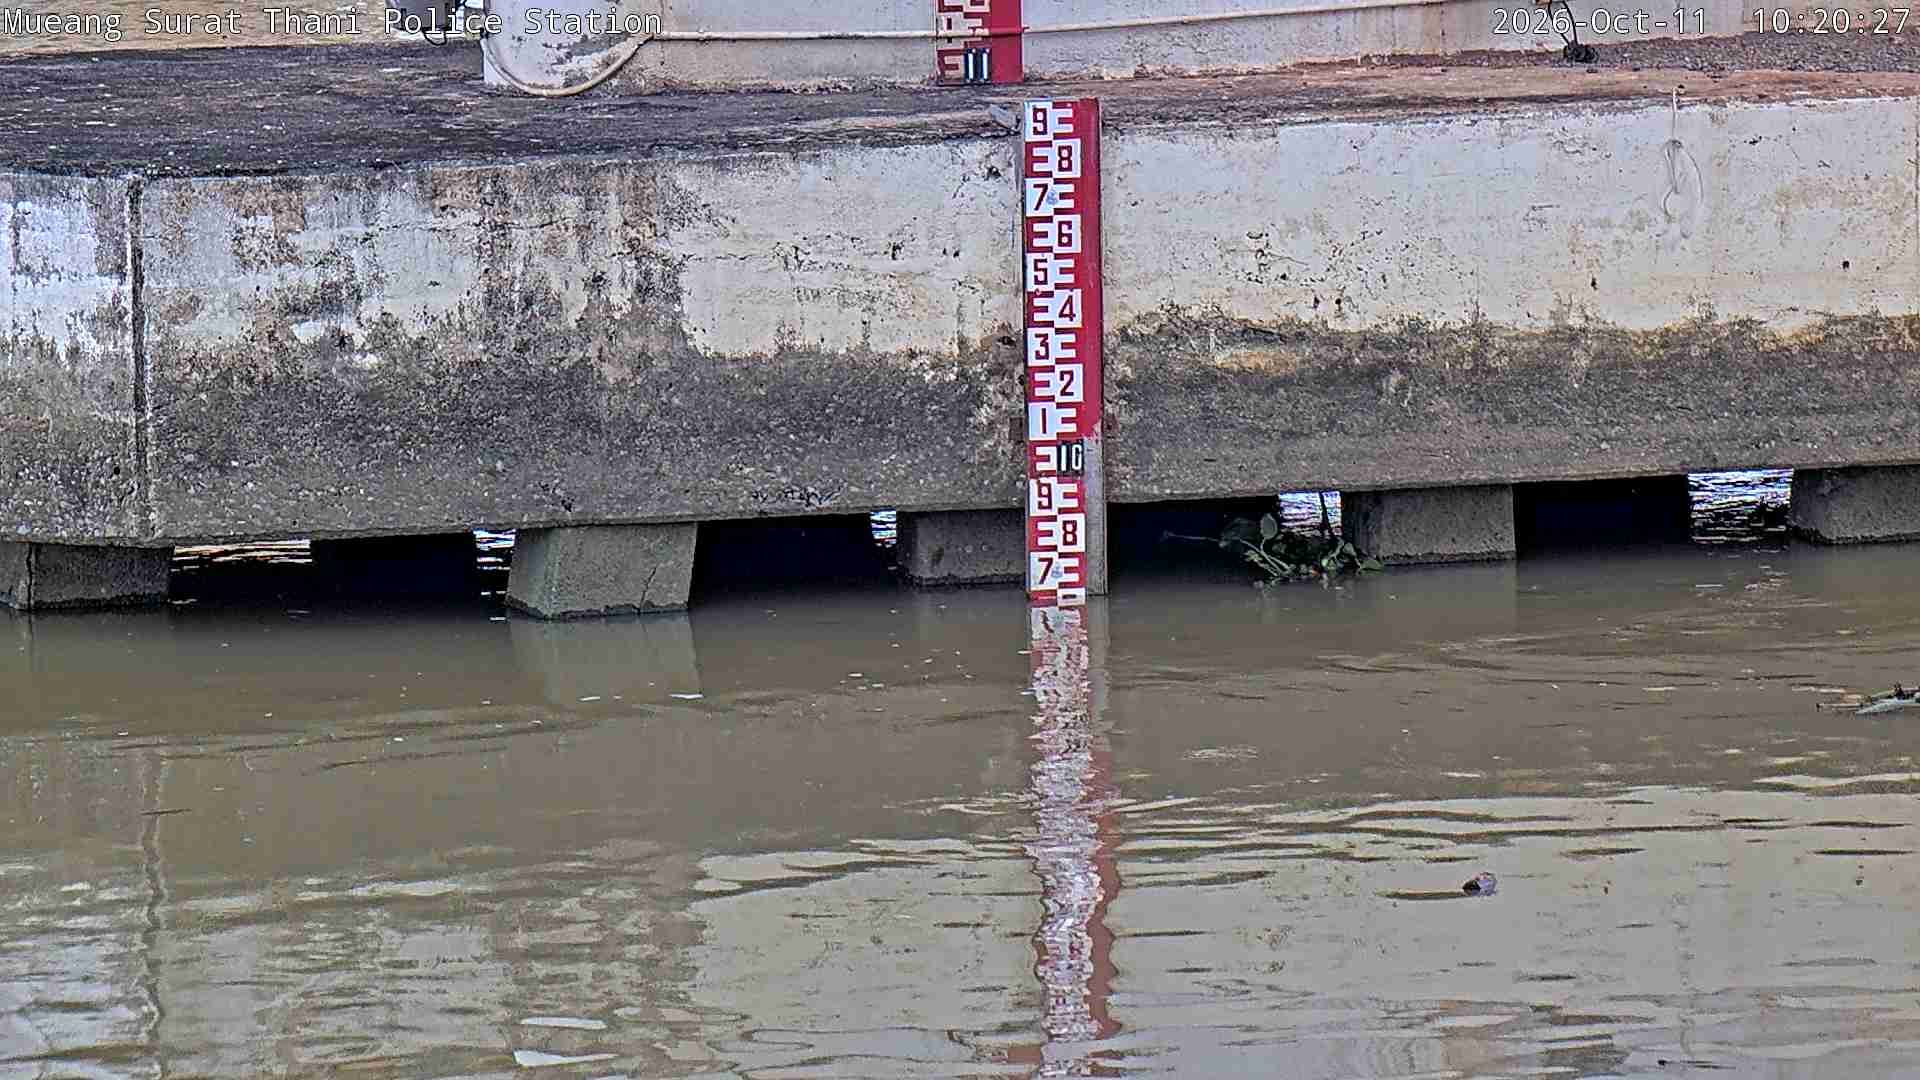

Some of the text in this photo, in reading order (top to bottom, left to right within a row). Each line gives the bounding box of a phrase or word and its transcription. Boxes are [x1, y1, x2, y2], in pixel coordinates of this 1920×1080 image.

[967, 51, 989, 80] 11
[1032, 107, 1048, 136] 9
[1057, 145, 1073, 172] 8
[1033, 183, 1049, 211] 7
[1057, 220, 1073, 248] 6
[1033, 258, 1048, 286] 5
[1058, 294, 1076, 322] 4
[1034, 333, 1050, 361] 3
[1059, 370, 1075, 397] 2
[1060, 444, 1083, 471] 10
[1037, 480, 1053, 510] 9
[1062, 519, 1078, 546] 8
[1037, 557, 1054, 585] 7
